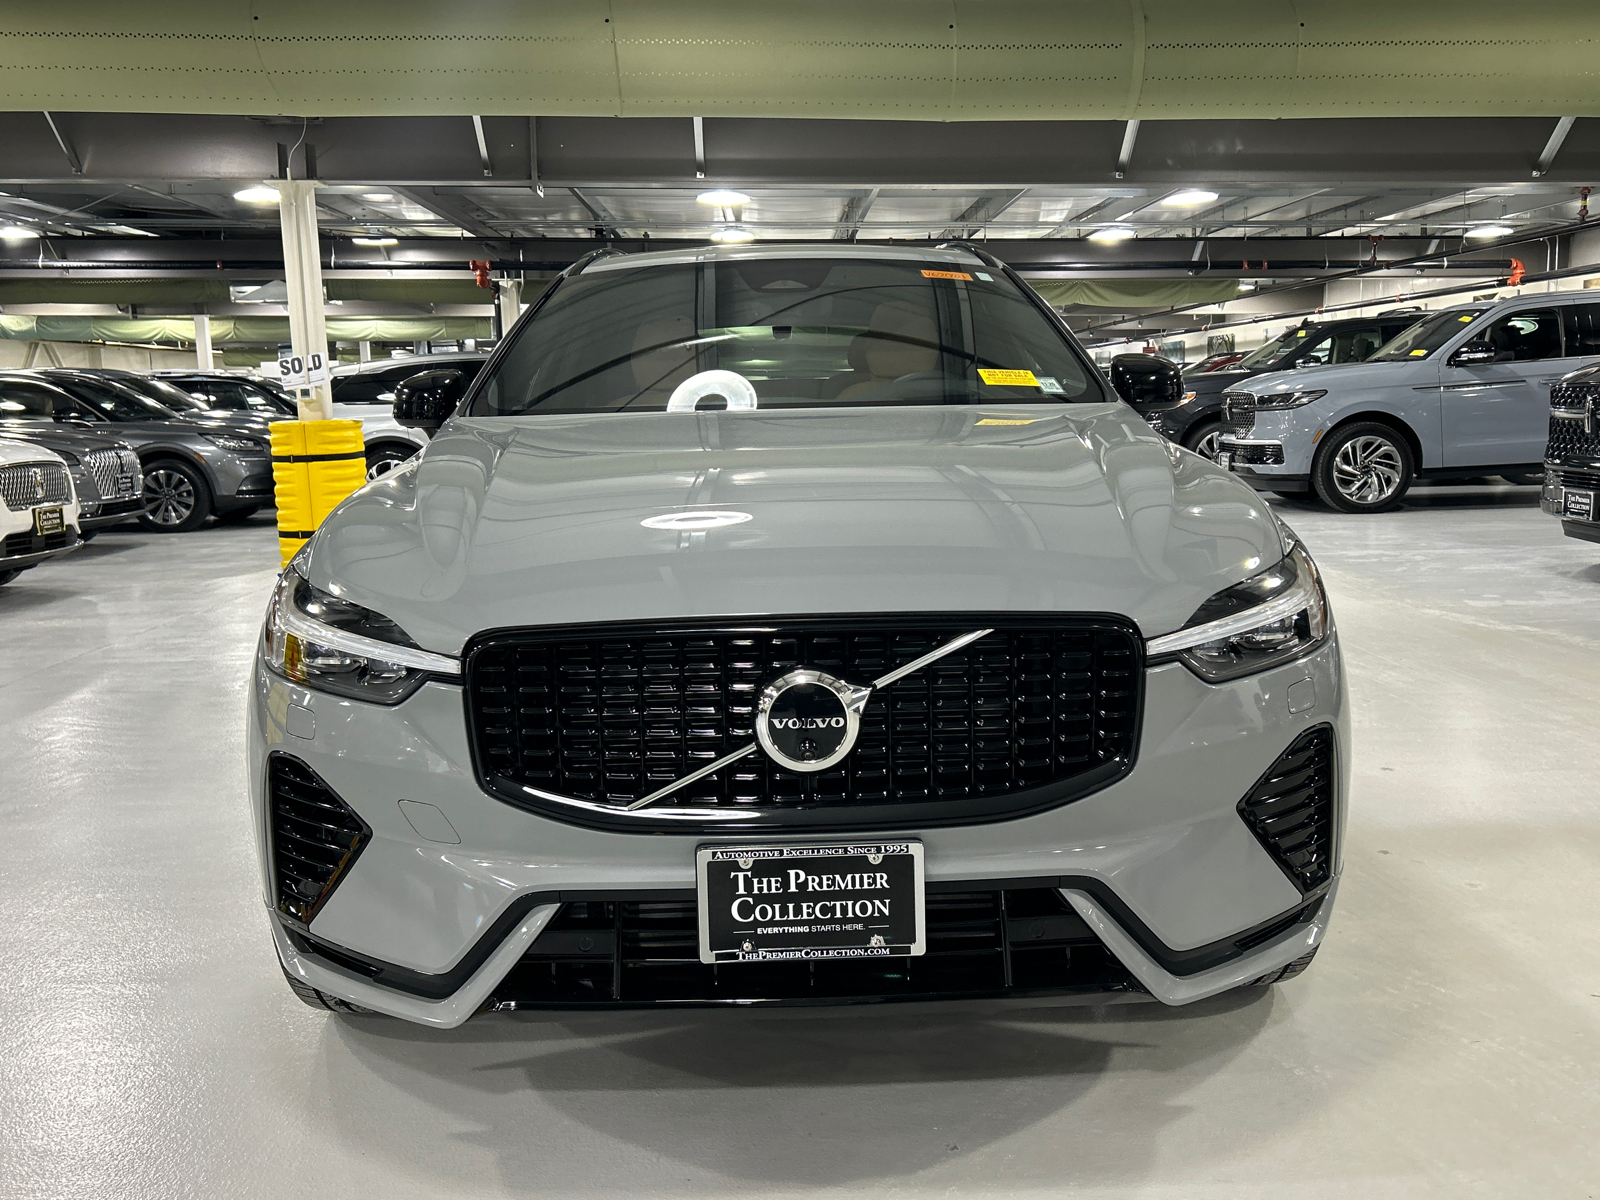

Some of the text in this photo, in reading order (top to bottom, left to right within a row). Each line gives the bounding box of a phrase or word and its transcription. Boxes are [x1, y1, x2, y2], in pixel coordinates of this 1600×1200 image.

[770, 717, 845, 729] VOLVO
[714, 844, 908, 860] AUTOMOTIVE EXCELLENCE SINCE 1995
[730, 869, 890, 895] THE PREMIER
[731, 897, 891, 923] COLLECTION
[756, 924, 866, 935] EVERYTHING STARTS HERE.
[736, 947, 890, 962] THEPREMIERCOLLECTION.COM
